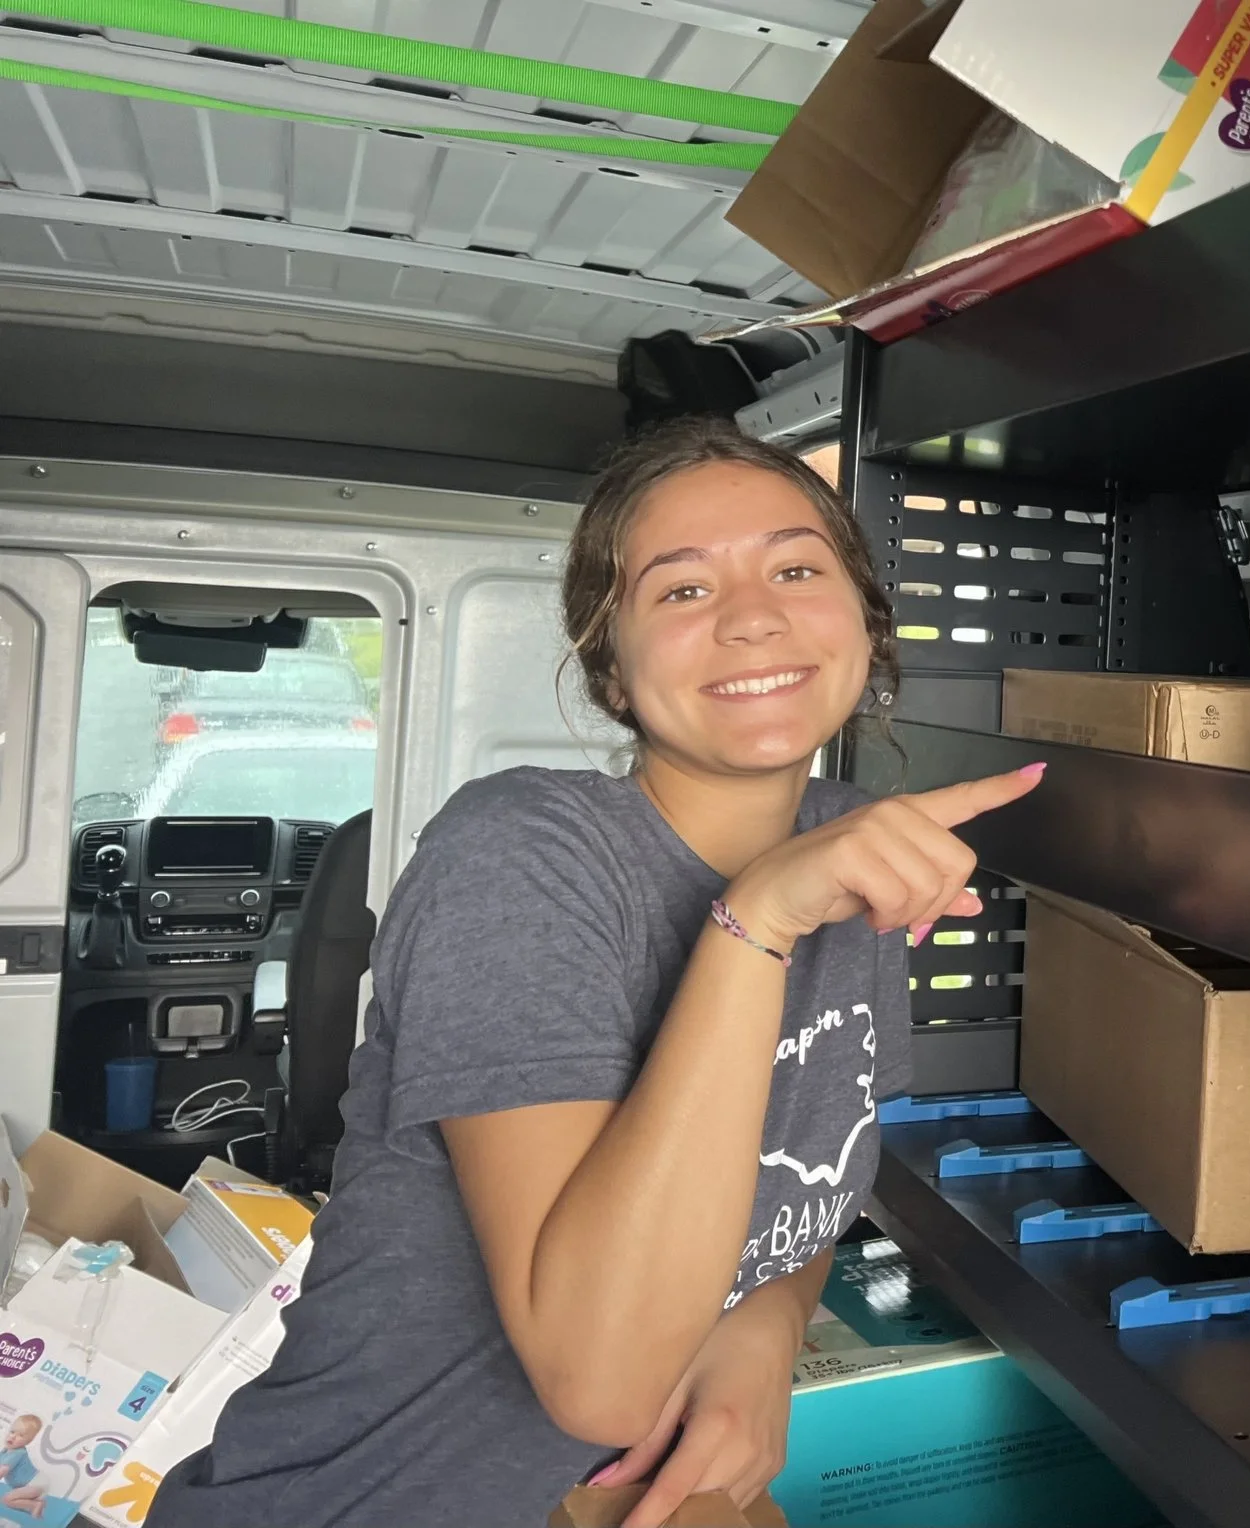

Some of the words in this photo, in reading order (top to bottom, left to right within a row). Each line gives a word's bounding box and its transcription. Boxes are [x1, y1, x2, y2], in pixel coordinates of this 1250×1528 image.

[1213, 32, 1248, 80] SUPER
[770, 1191, 853, 1257] BANK
[40, 1360, 101, 1396] Diapers
[800, 1358, 842, 1371] 136
[128, 1397, 147, 1413] 4
[820, 1462, 873, 1481] WARNING:
